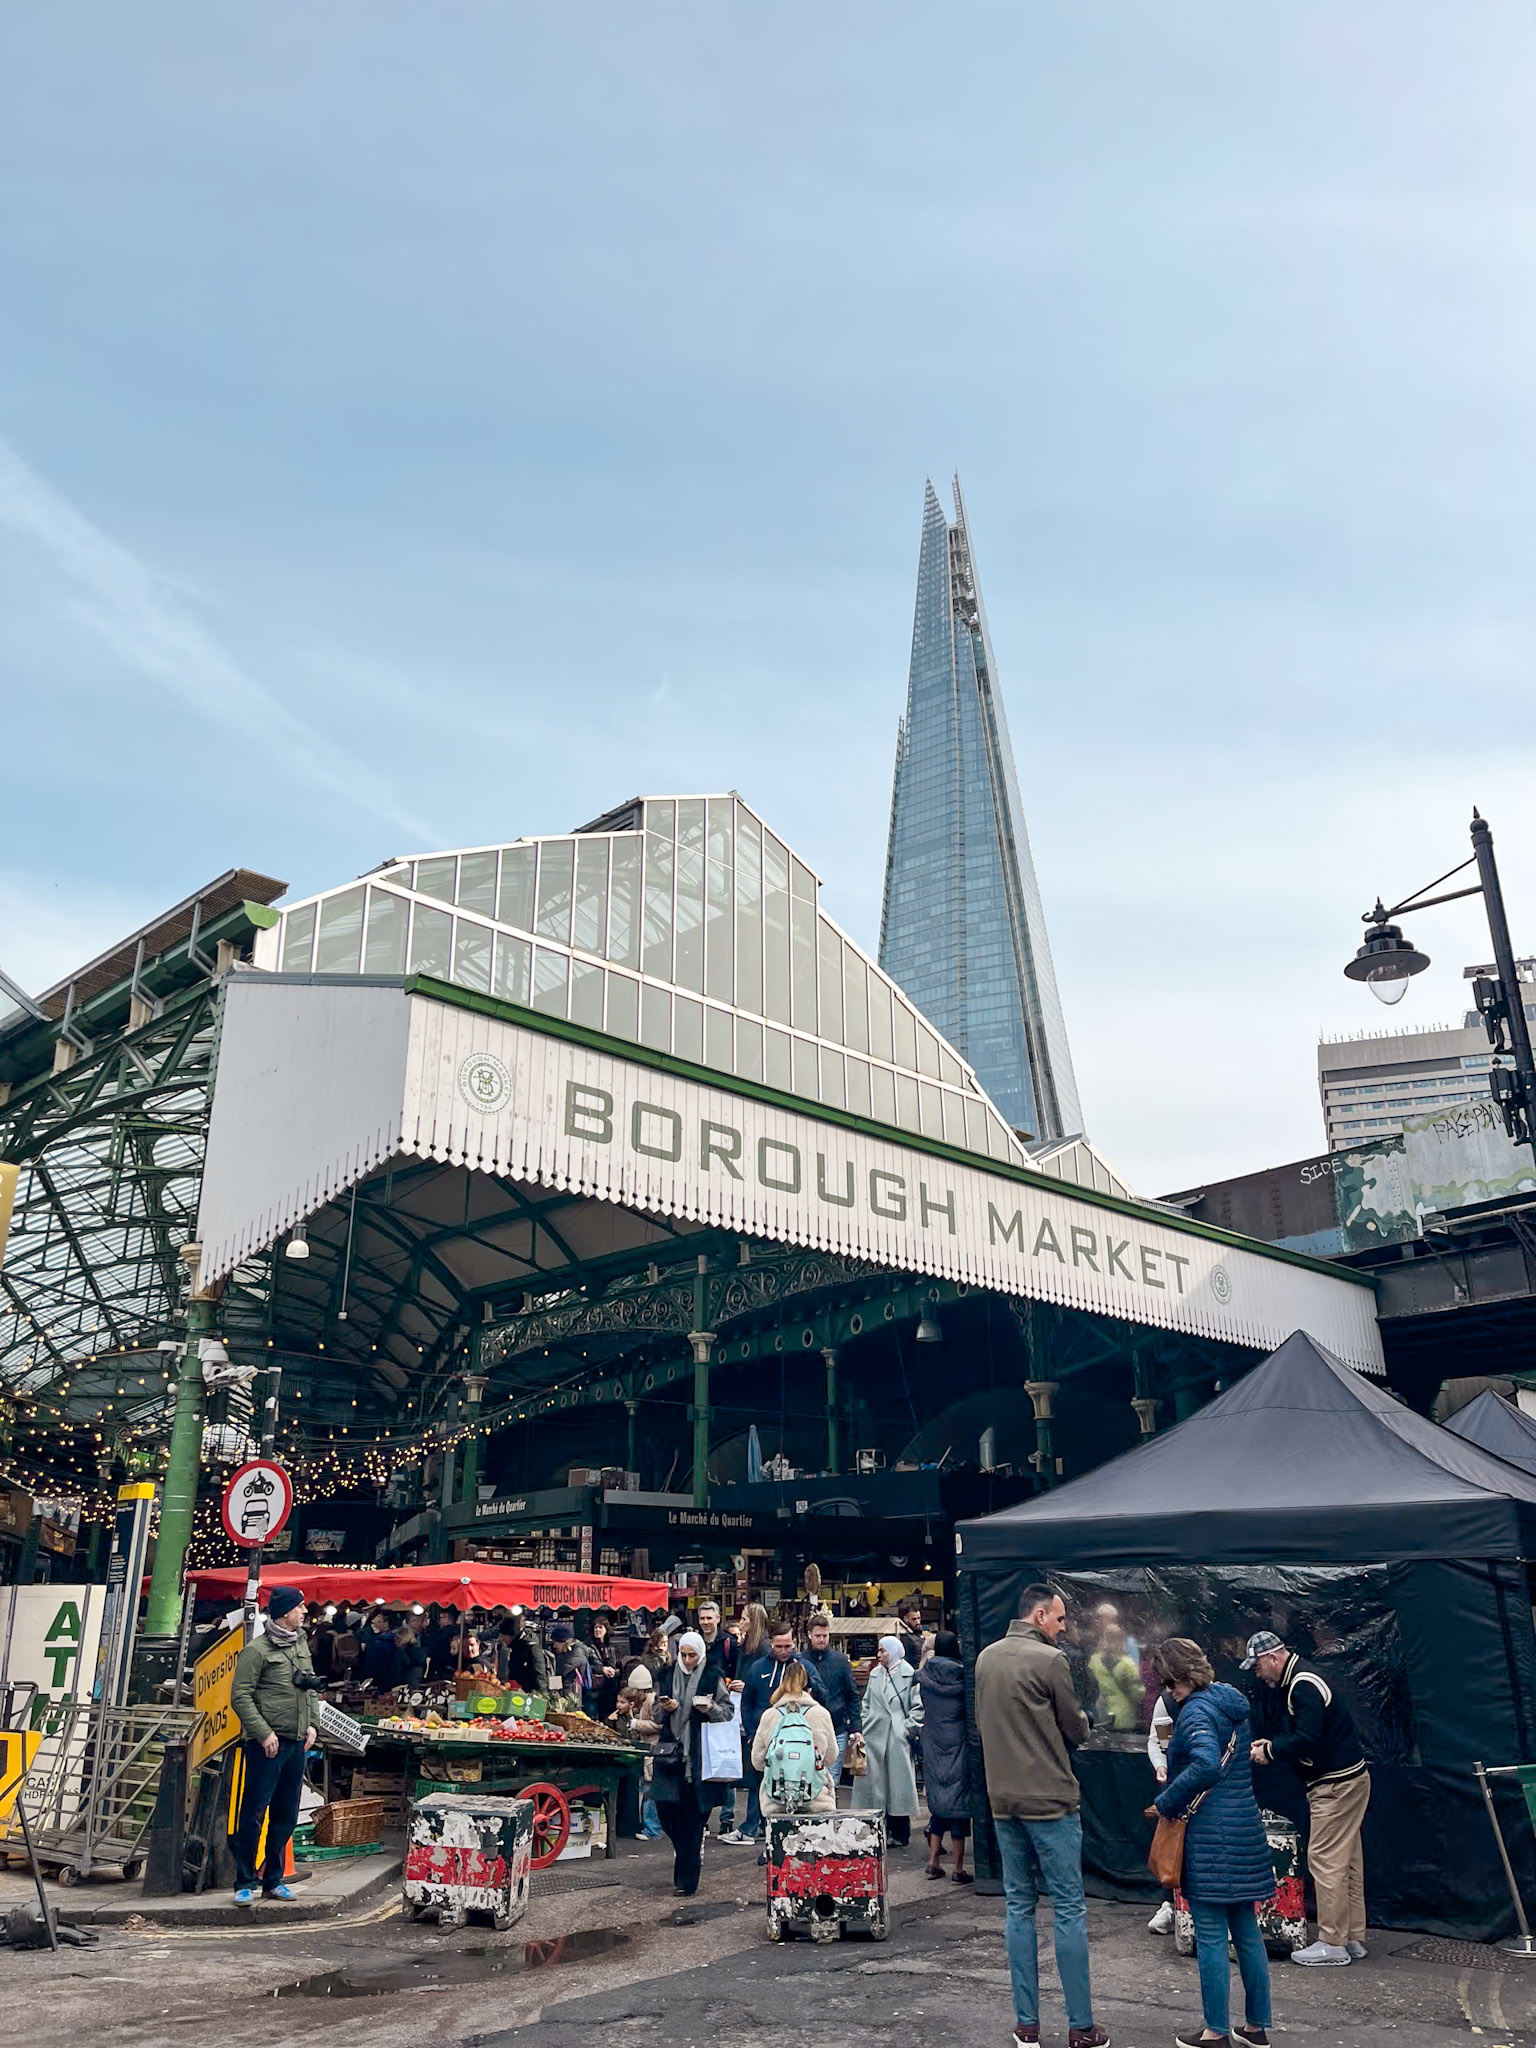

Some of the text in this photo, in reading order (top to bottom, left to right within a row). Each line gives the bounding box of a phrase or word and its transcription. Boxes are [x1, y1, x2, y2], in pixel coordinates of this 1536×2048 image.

[1300, 1158, 1343, 1184] SIDE
[564, 1080, 1190, 1294] BOROUGH MARKET
[482, 1502, 498, 1515] Marché
[499, 1501, 505, 1513] du
[506, 1498, 526, 1514] Quartier
[668, 1511, 753, 1528] Le Marché du Quartier
[533, 1585, 613, 1603] BOROUGH MARKET
[203, 1705, 228, 1744] ENDS
